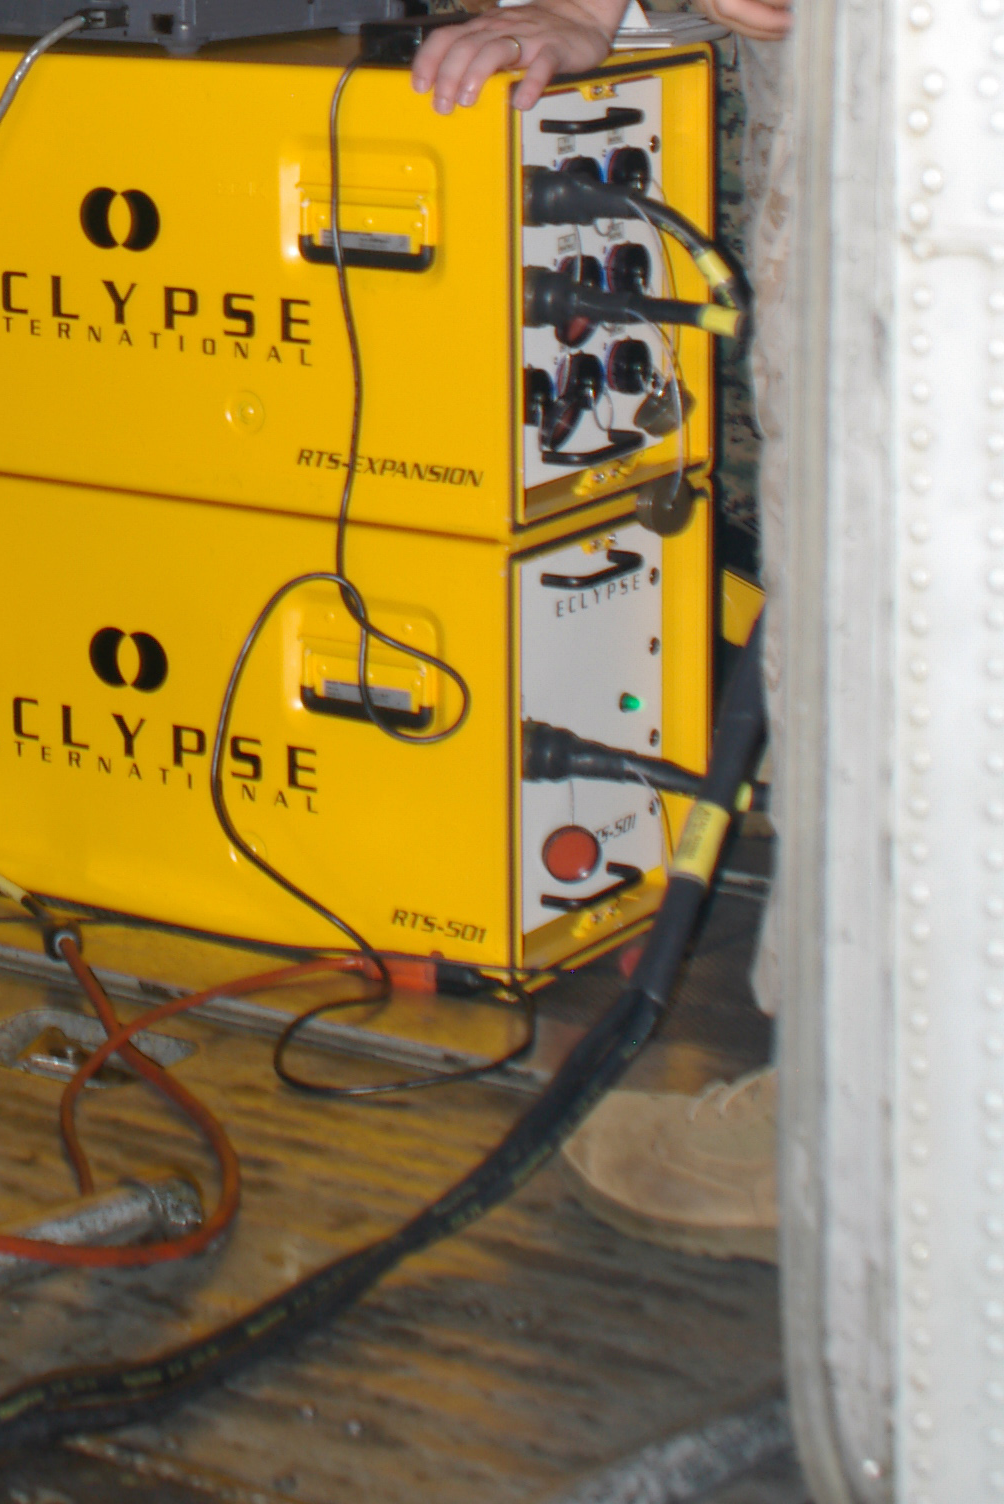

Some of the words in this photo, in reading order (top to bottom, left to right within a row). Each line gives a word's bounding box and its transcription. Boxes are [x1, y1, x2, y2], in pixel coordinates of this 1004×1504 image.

[556, 573, 641, 617] ECLYPSE
[595, 813, 636, 843] TS-501
[391, 909, 486, 944] RTS-501
